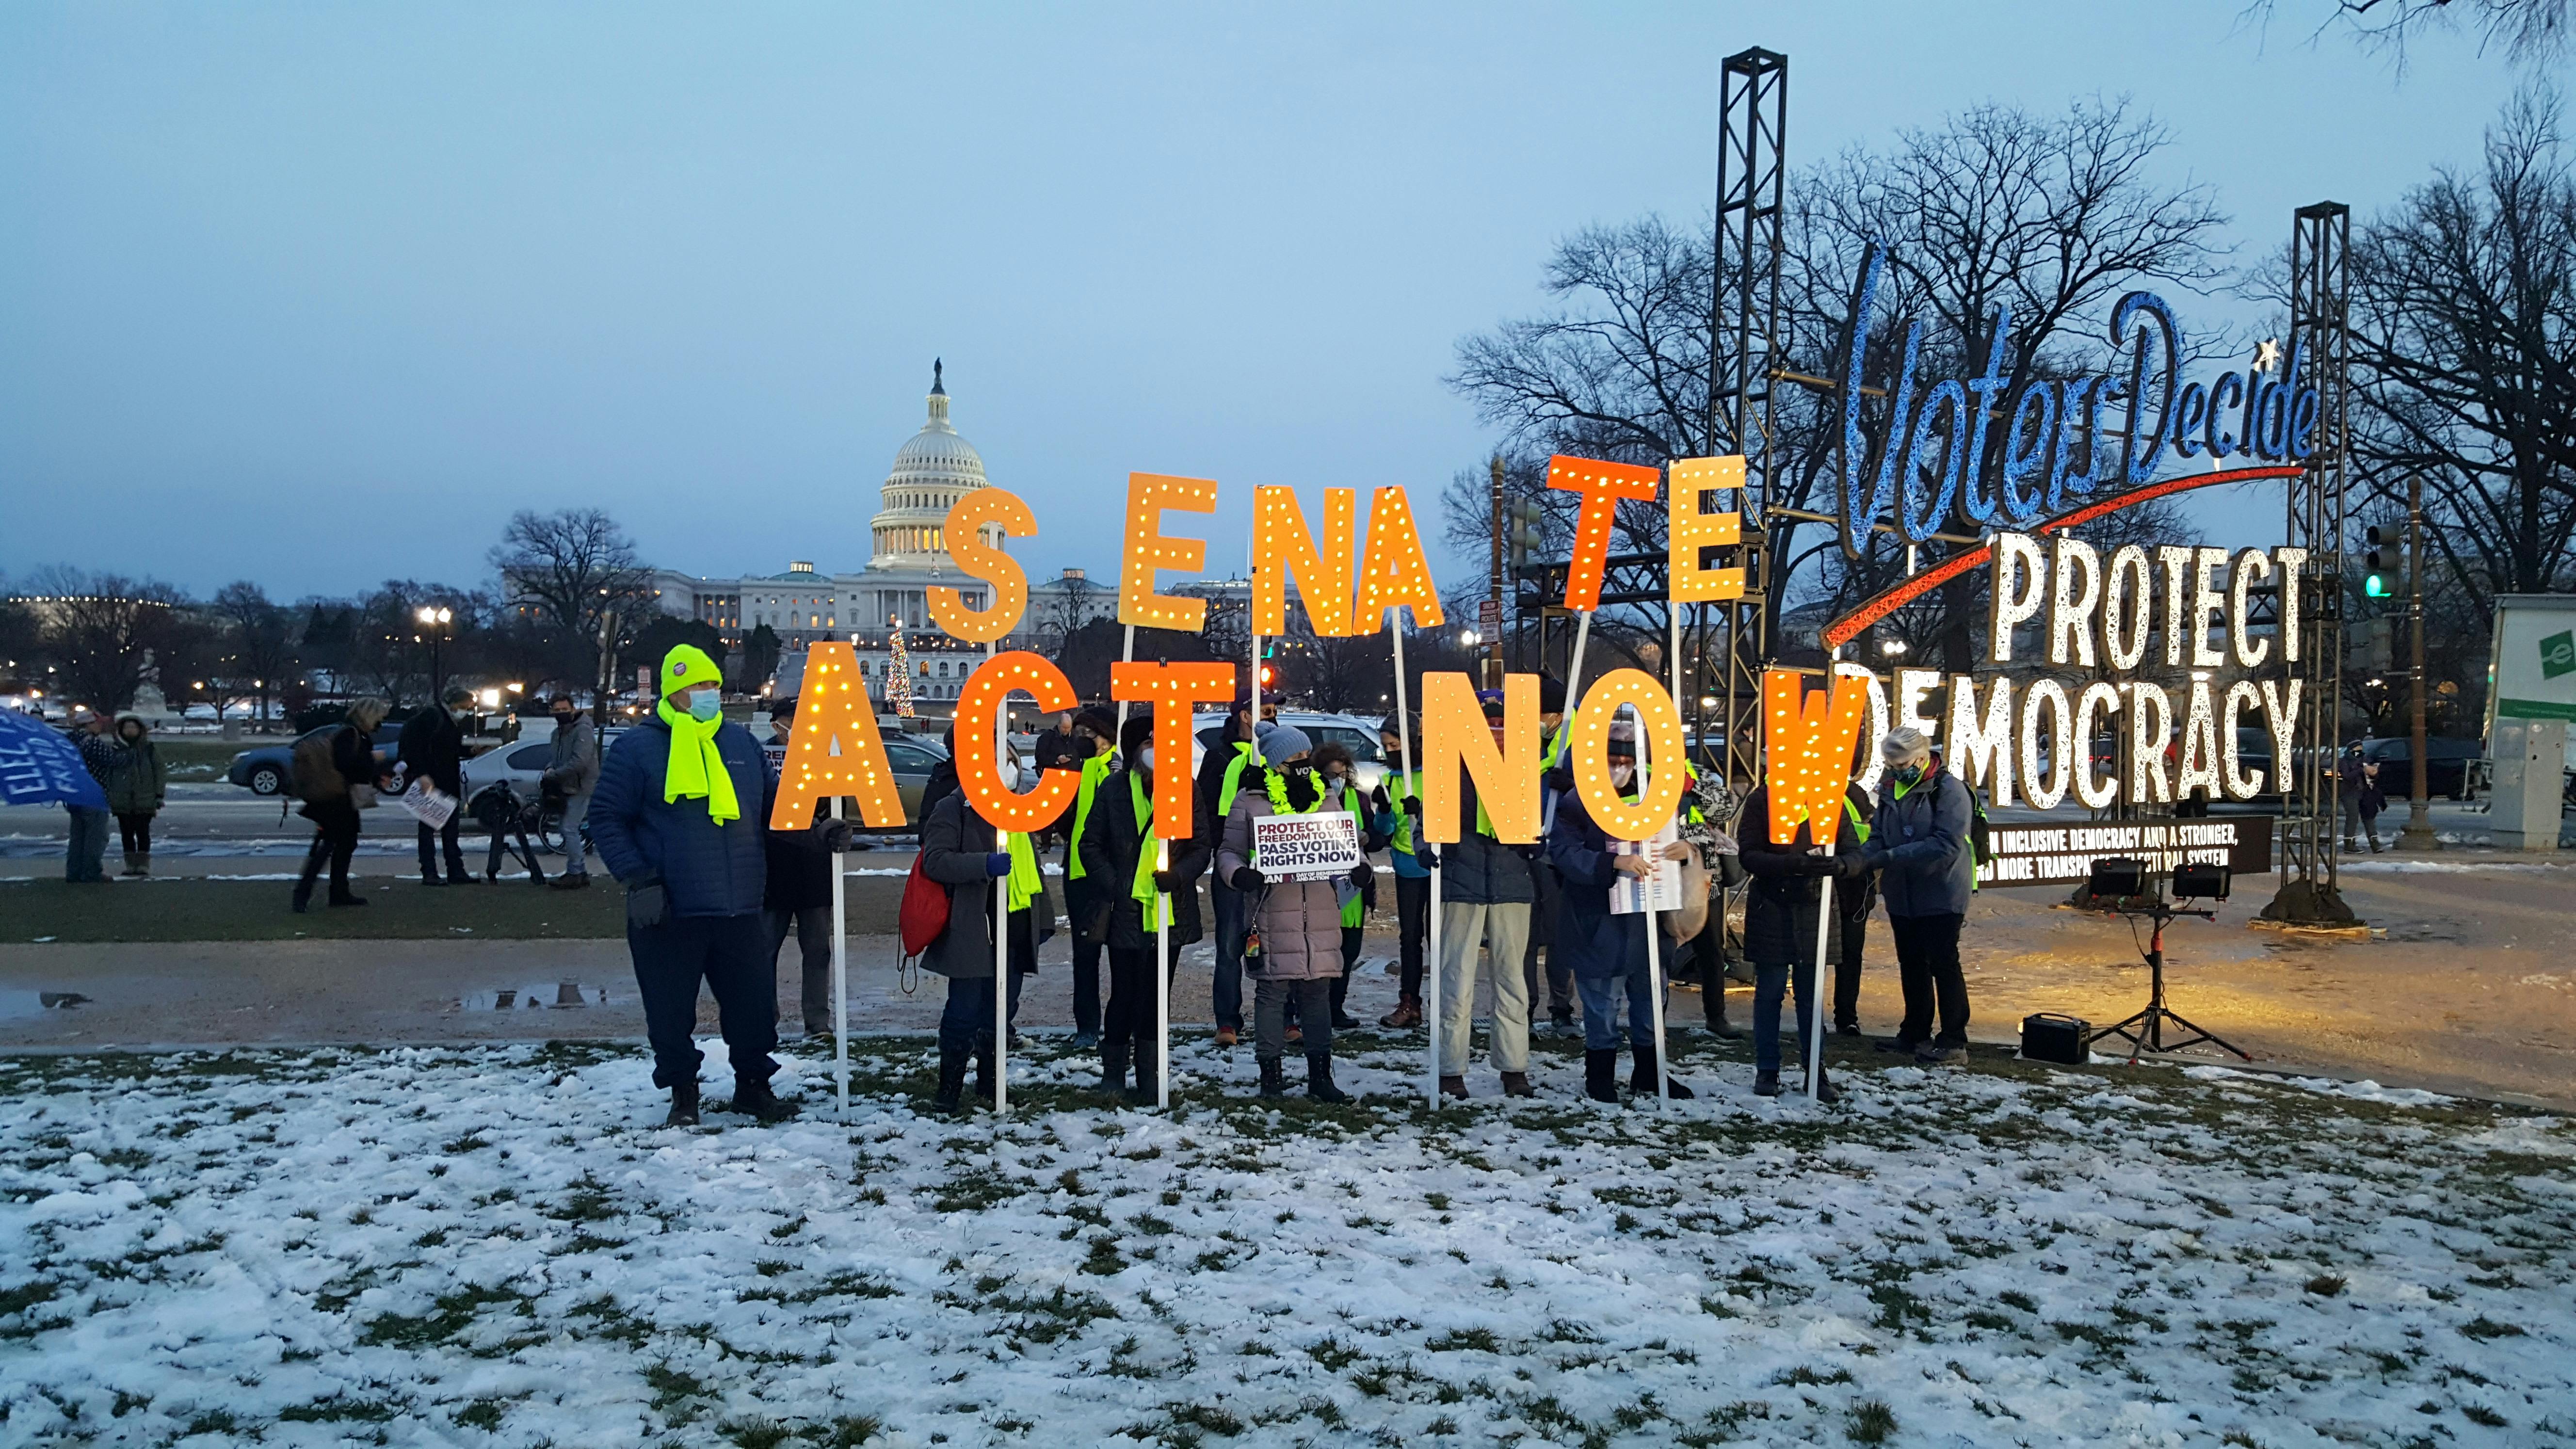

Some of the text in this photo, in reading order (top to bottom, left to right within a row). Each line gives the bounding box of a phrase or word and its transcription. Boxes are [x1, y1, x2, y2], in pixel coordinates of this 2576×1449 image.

[1841, 242, 2319, 559] Voters Decide
[1993, 532, 2307, 670] PROTECT
[771, 641, 1868, 845] ACT NOW
[1257, 820, 1353, 835] PROTECT OUR
[1258, 833, 1310, 843] FREEDOM
[1327, 830, 1355, 838] VOTE
[2002, 829, 2067, 853] INCLUSIVE
[2070, 827, 2141, 851] DEMOCRACY
[2144, 826, 2167, 850] AND
[2169, 826, 2178, 847] A
[2179, 824, 2238, 846] STRONGER,
[1258, 838, 1356, 855] PASS VOTING
[1260, 850, 1356, 867] RIGHTS NOW
[1996, 857, 2034, 881] MORE
[2035, 853, 2121, 879] TRANSPA
